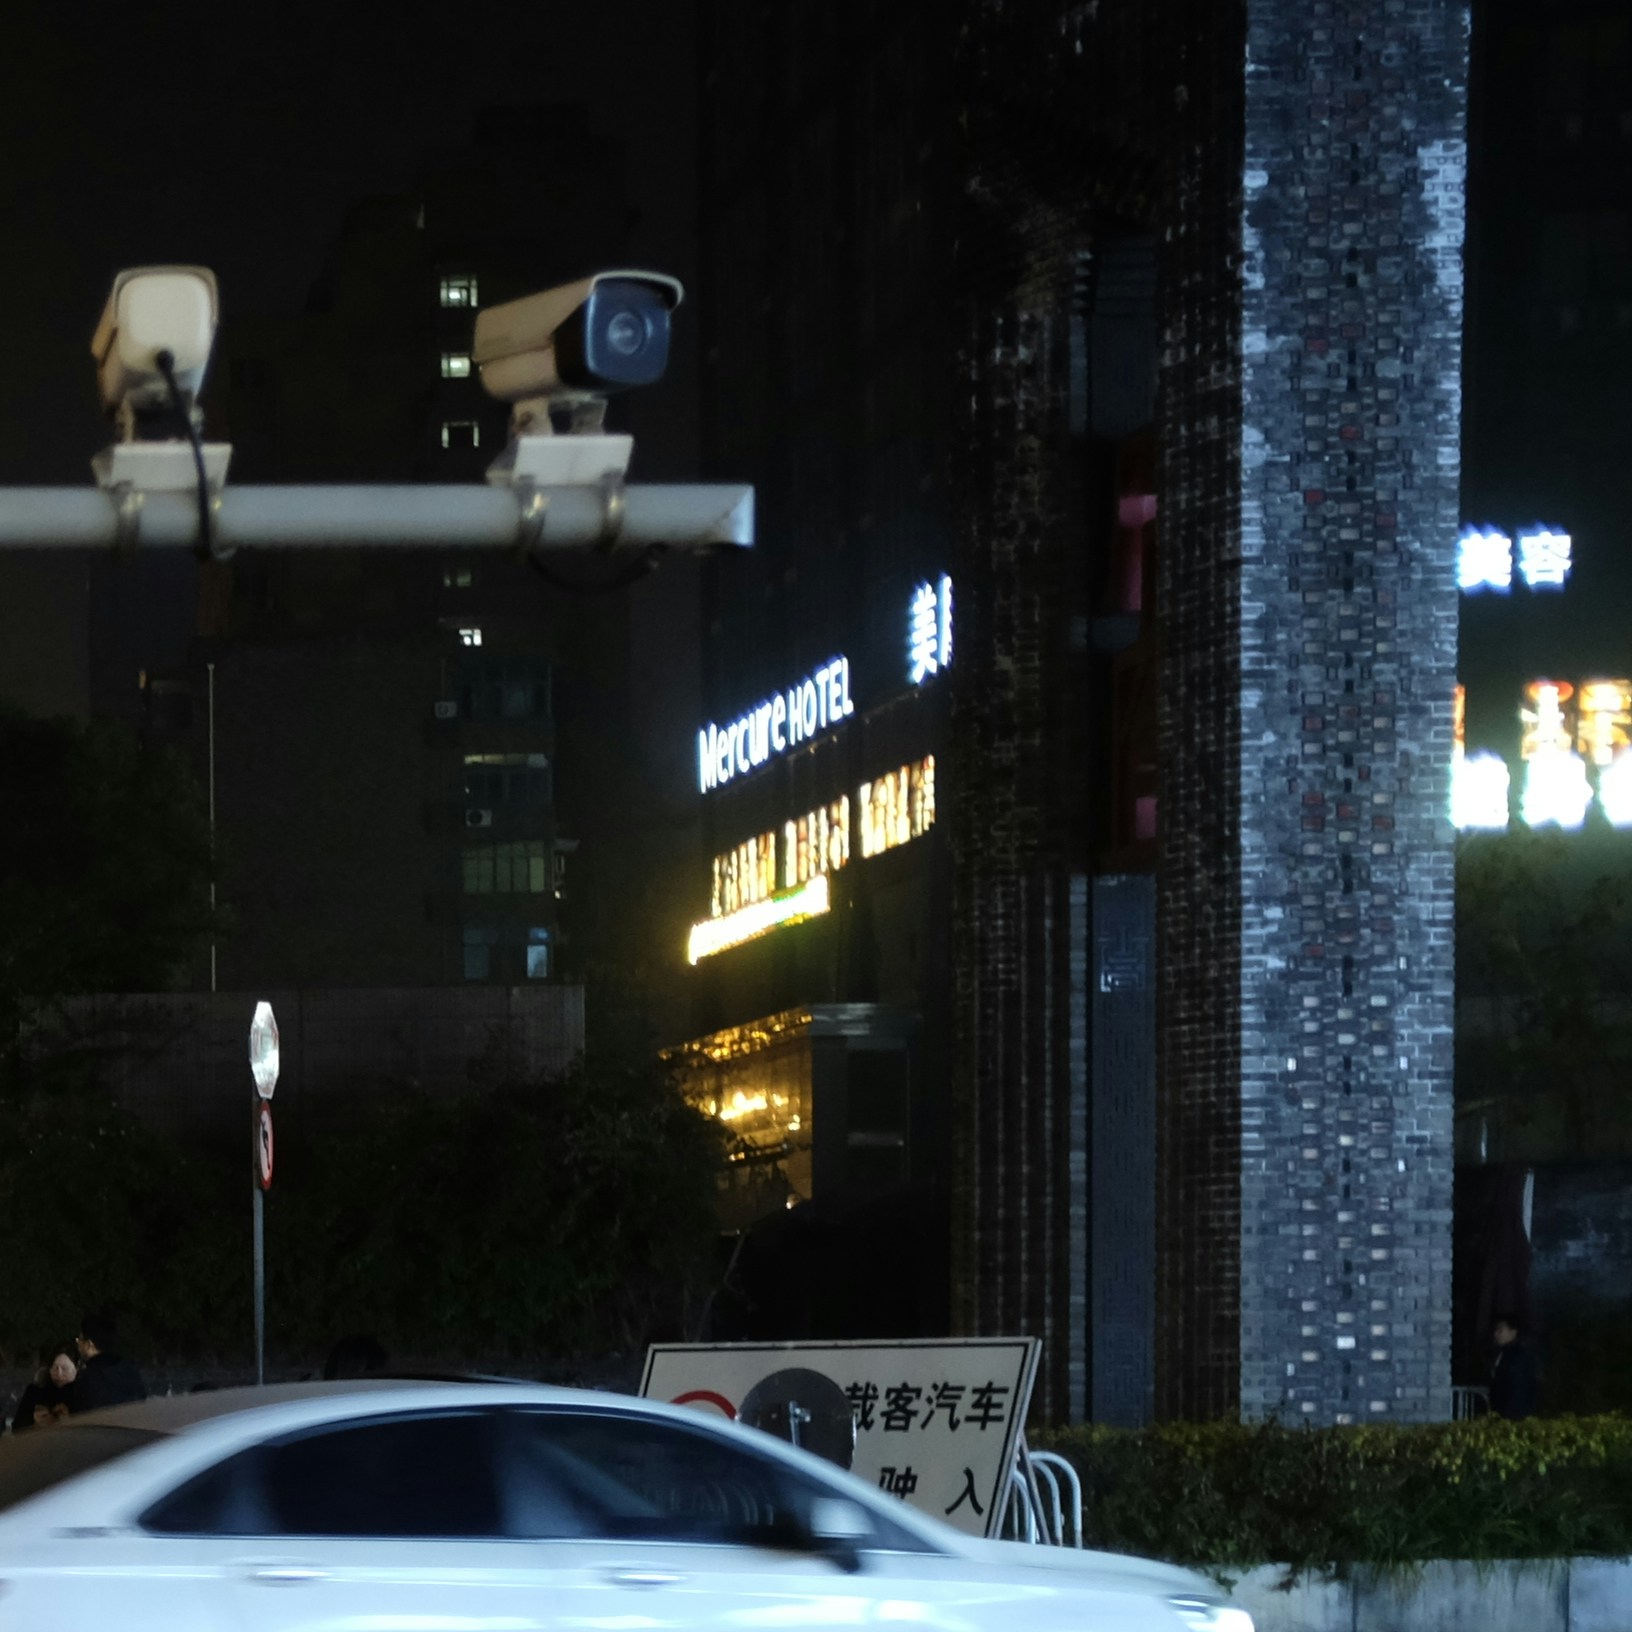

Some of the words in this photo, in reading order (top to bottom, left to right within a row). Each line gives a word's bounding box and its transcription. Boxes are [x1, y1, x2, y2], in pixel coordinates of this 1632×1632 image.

[698, 693, 786, 794] Mercure
[789, 656, 854, 746] HOTEL
[910, 574, 953, 684] 美
